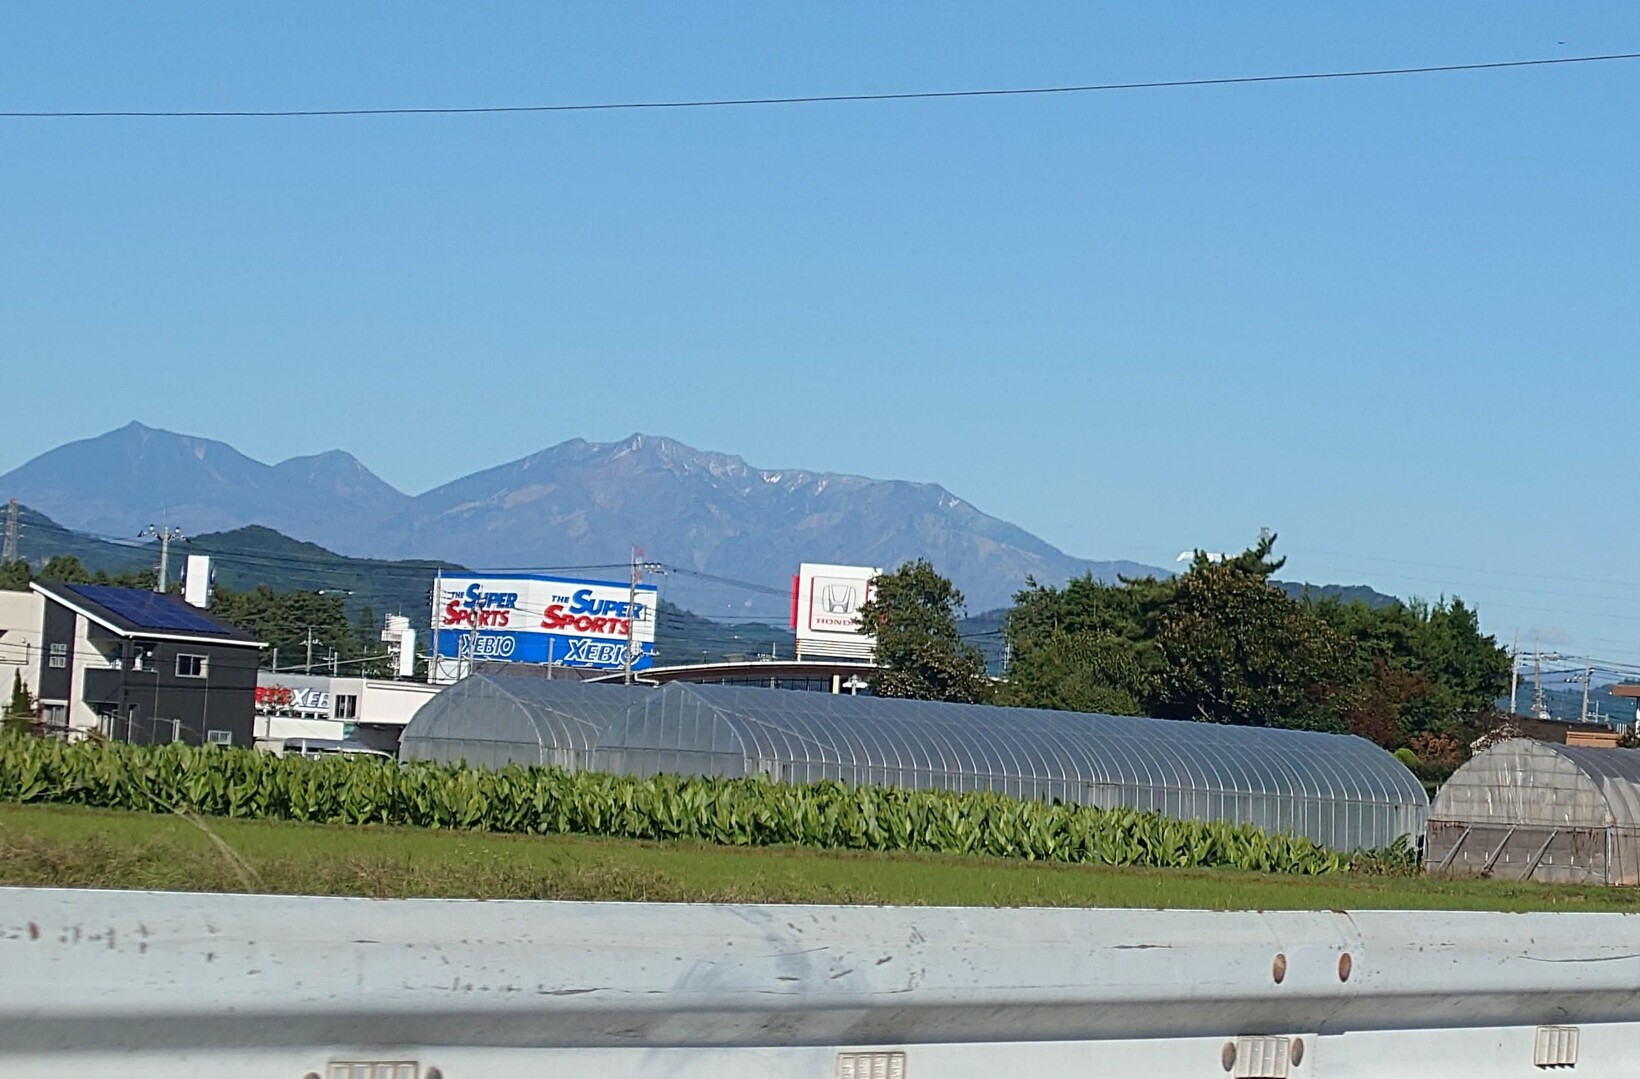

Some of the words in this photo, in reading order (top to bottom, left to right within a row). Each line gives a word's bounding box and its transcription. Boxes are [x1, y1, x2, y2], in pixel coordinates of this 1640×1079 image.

[451, 591, 465, 600] THE
[464, 583, 518, 609] SUPER
[552, 595, 570, 604] THE
[569, 589, 643, 619] SUPER
[444, 600, 510, 627] SPORTS
[540, 605, 631, 635] SPORTS
